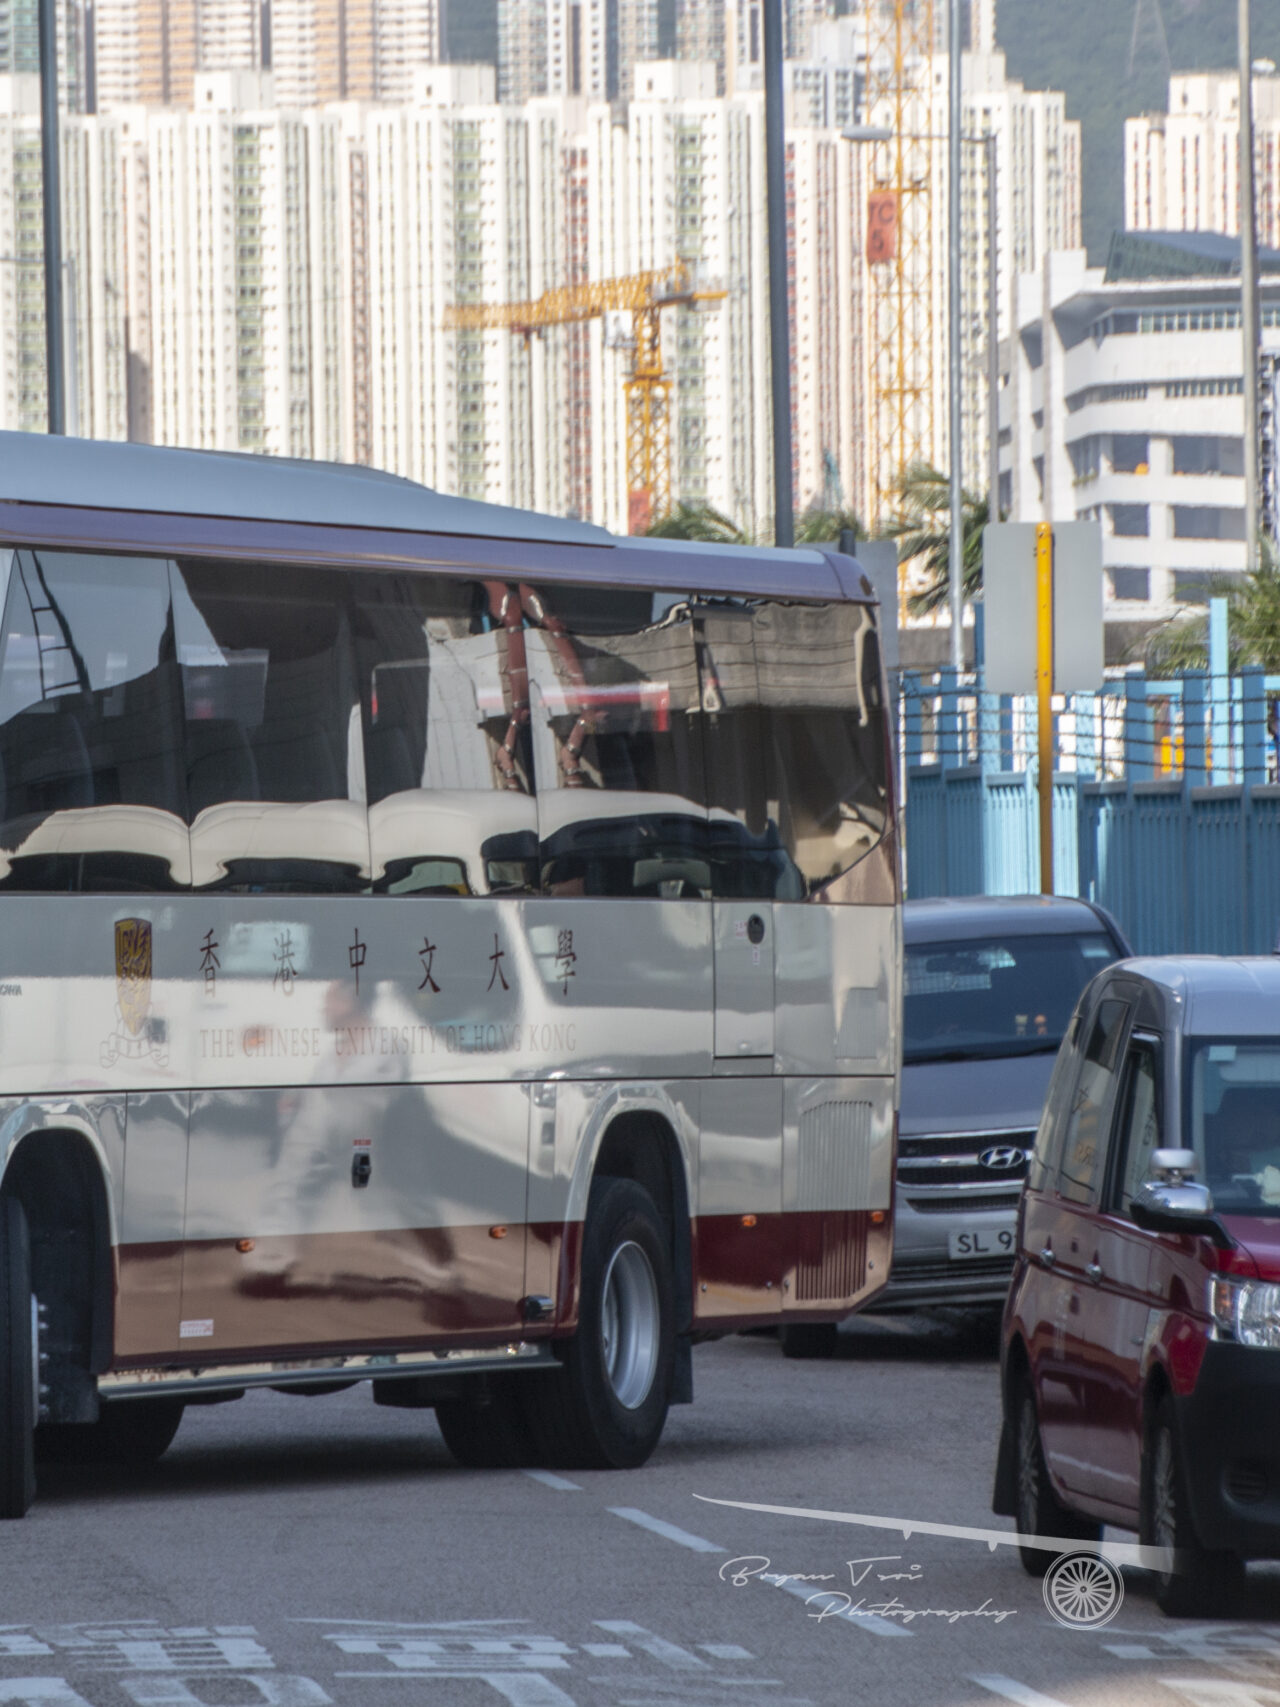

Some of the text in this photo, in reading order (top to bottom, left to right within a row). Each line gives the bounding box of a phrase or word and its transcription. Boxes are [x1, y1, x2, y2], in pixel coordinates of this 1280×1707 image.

[199, 927, 577, 998] 香港中文大學
[200, 1022, 577, 1058] THE CHINESE UNIVERSITY OF HONG KONG
[957, 1230, 1017, 1254] SL 9
